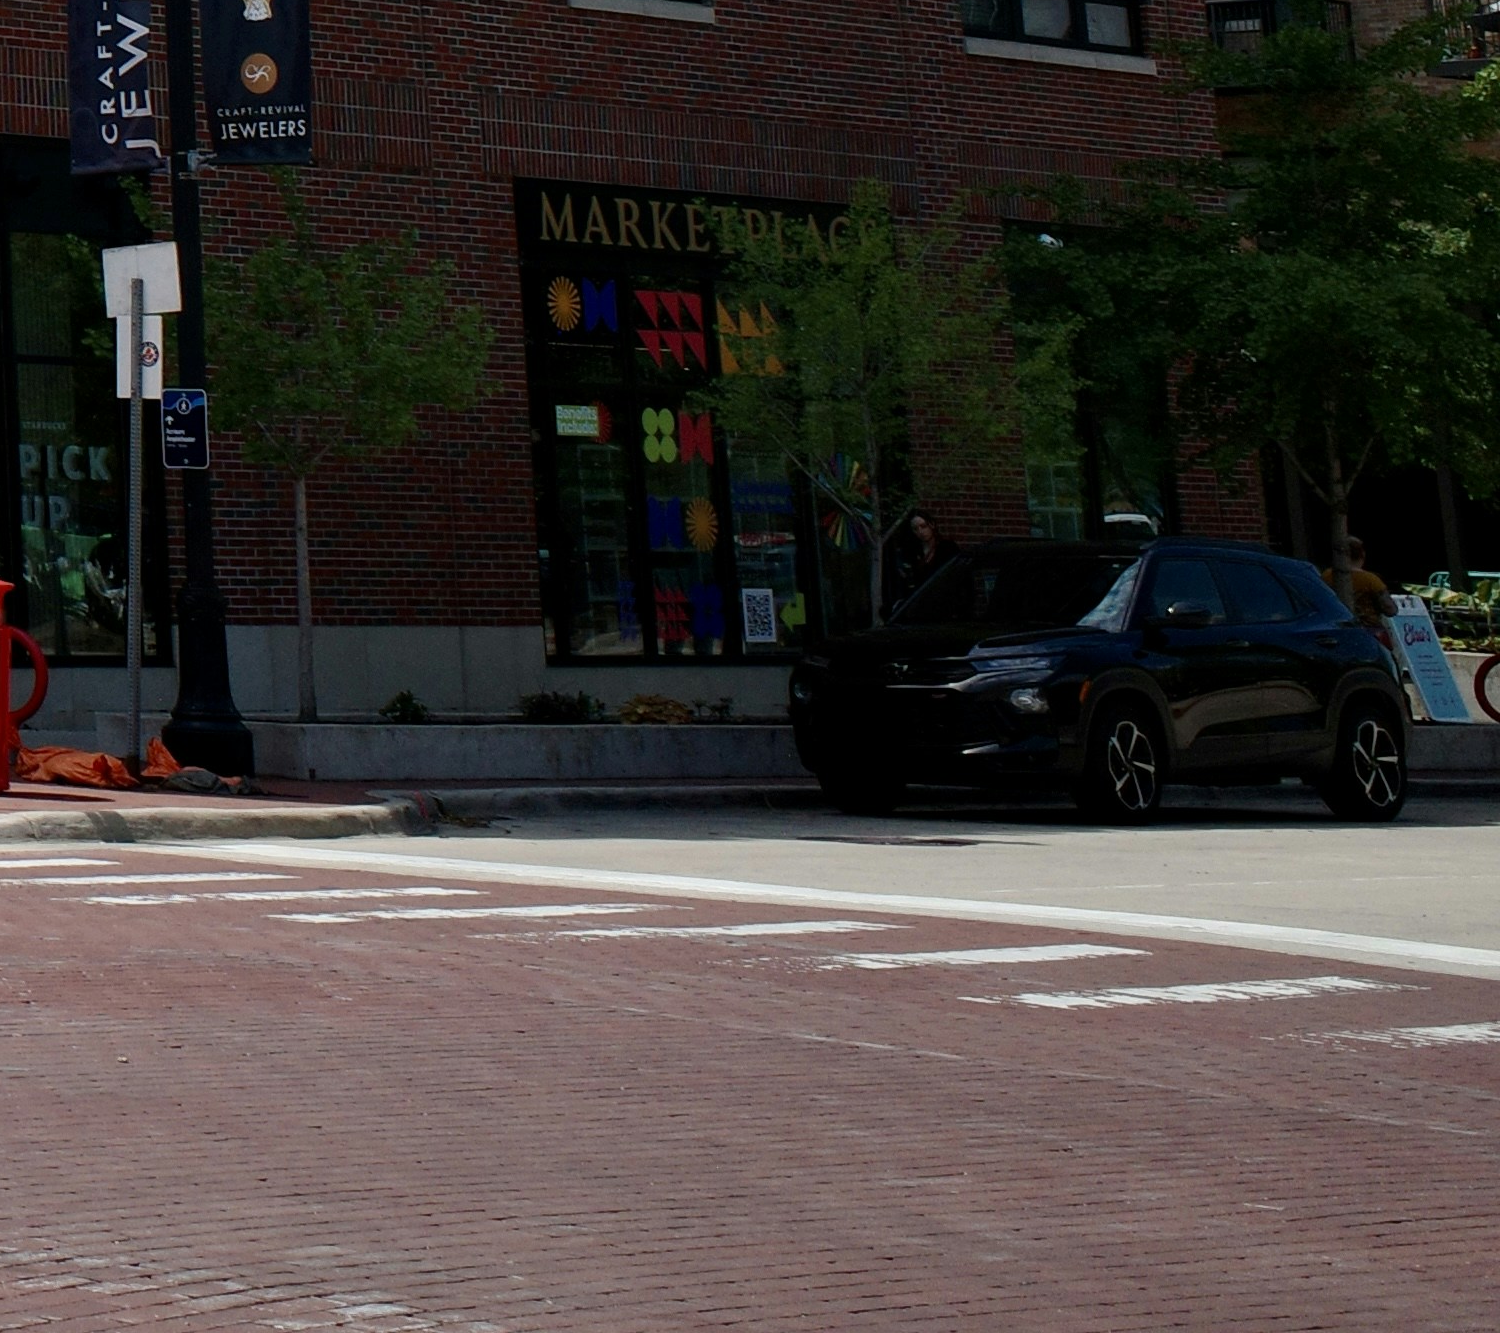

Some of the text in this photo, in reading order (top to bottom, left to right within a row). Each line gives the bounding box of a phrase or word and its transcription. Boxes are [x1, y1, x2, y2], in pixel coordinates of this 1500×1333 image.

[216, 104, 307, 118] CRAFT-REVIVAL
[219, 116, 307, 141] JEWELERS
[18, 444, 112, 482] PICK
[20, 494, 69, 530] UP
